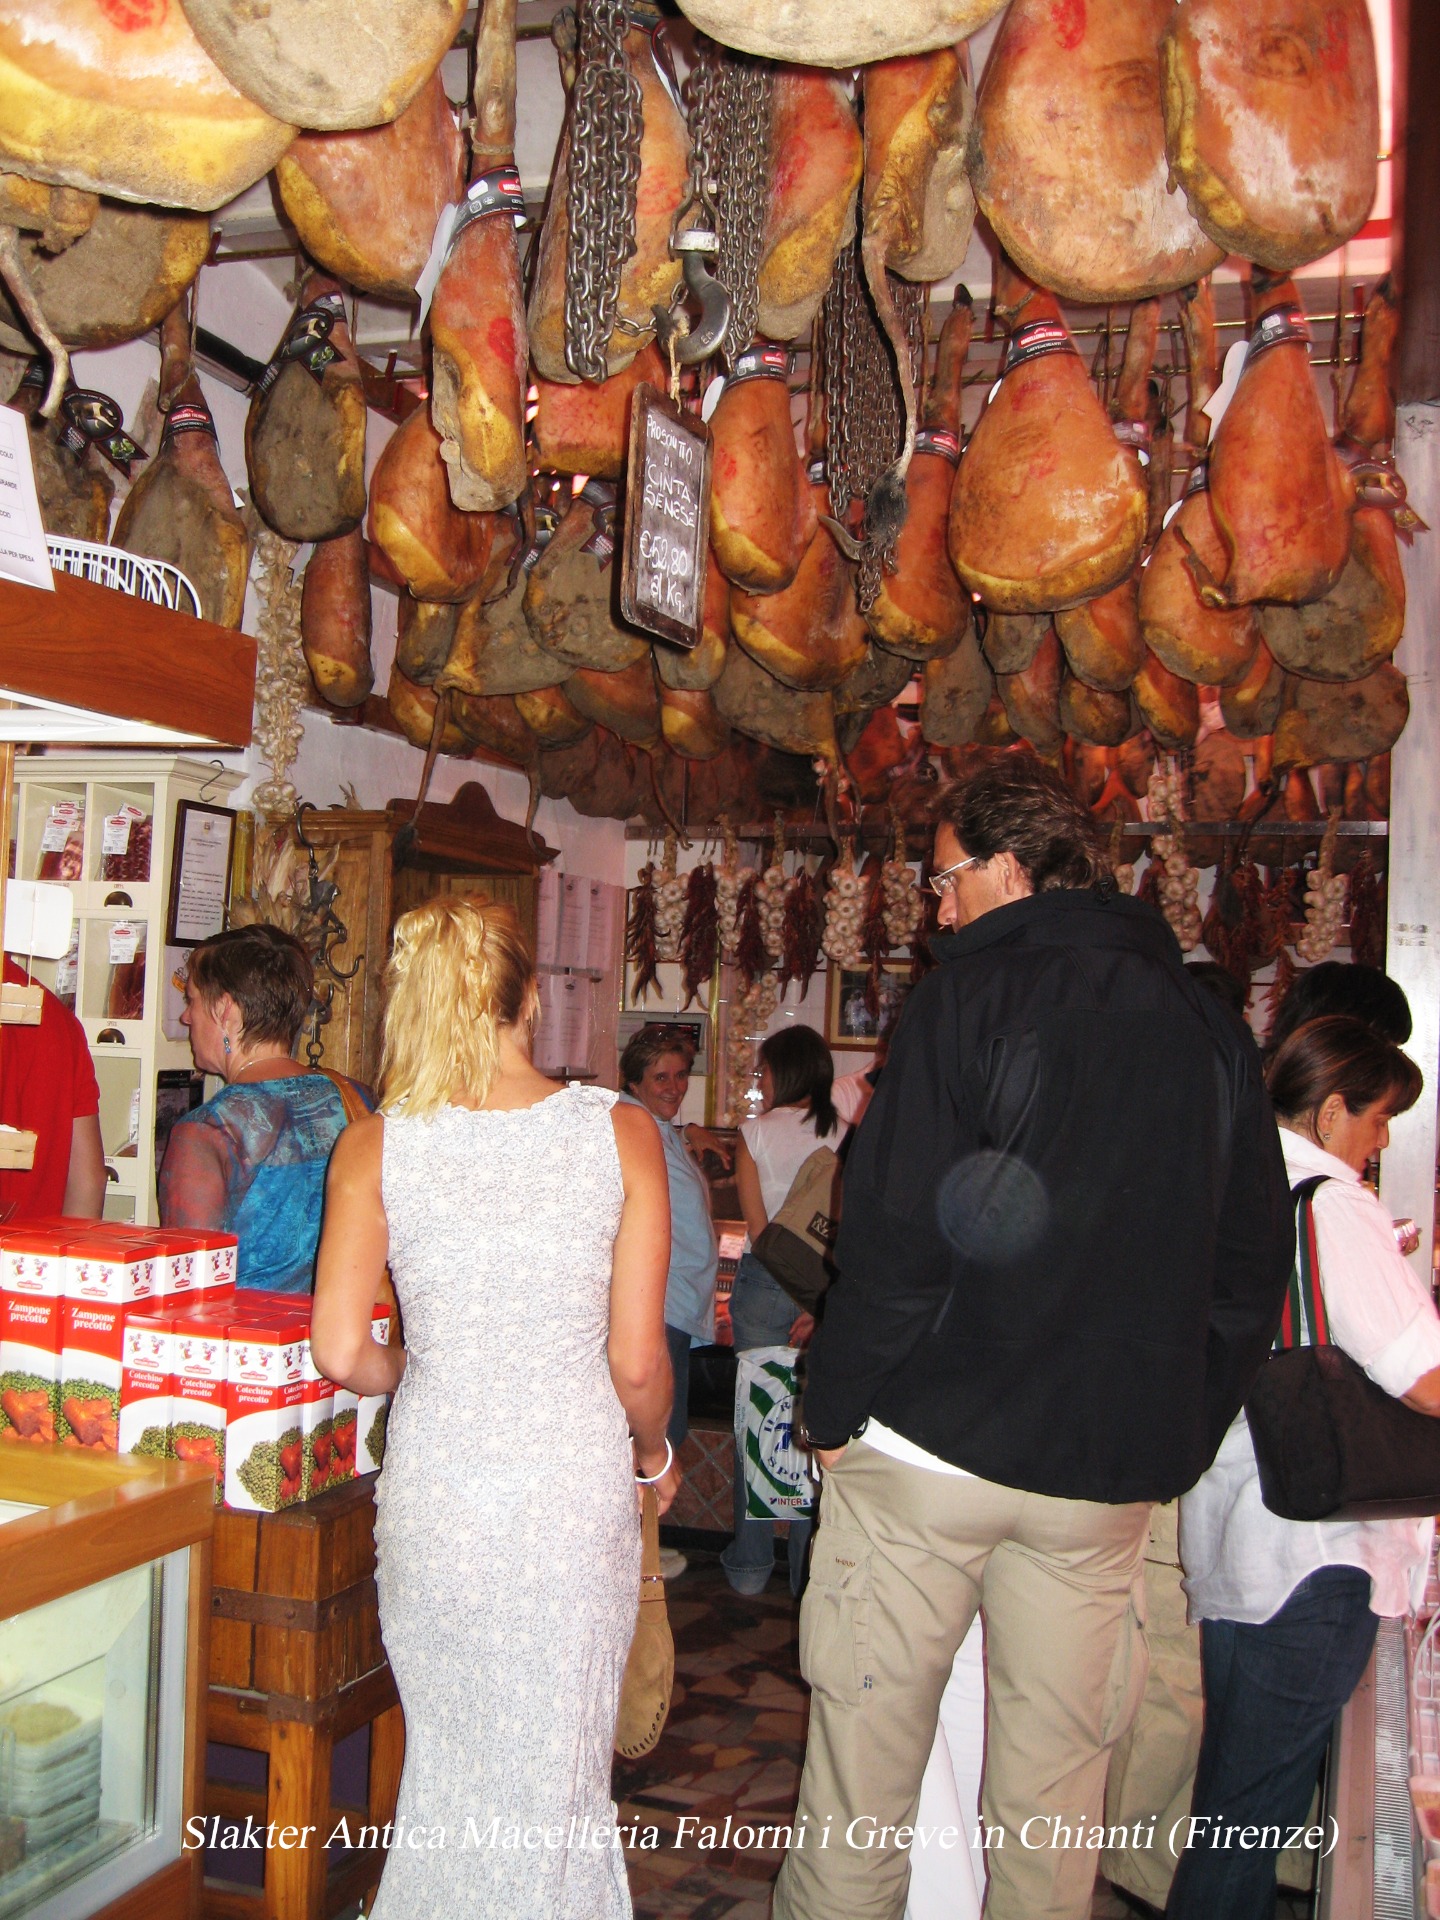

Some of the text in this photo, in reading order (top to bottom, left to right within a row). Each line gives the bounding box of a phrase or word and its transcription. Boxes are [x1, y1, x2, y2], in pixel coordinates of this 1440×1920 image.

[8, 1300, 51, 1315] Zampone
[10, 1312, 48, 1324] precotto
[71, 1307, 116, 1322] Zampone
[73, 1319, 113, 1331] precotto
[129, 1369, 164, 1383] Cotechino
[131, 1380, 160, 1390] precotto
[180, 1377, 216, 1389] Cotechino
[182, 1387, 213, 1397] precotto
[235, 1384, 273, 1396] Cotechino
[238, 1394, 270, 1404] precotto
